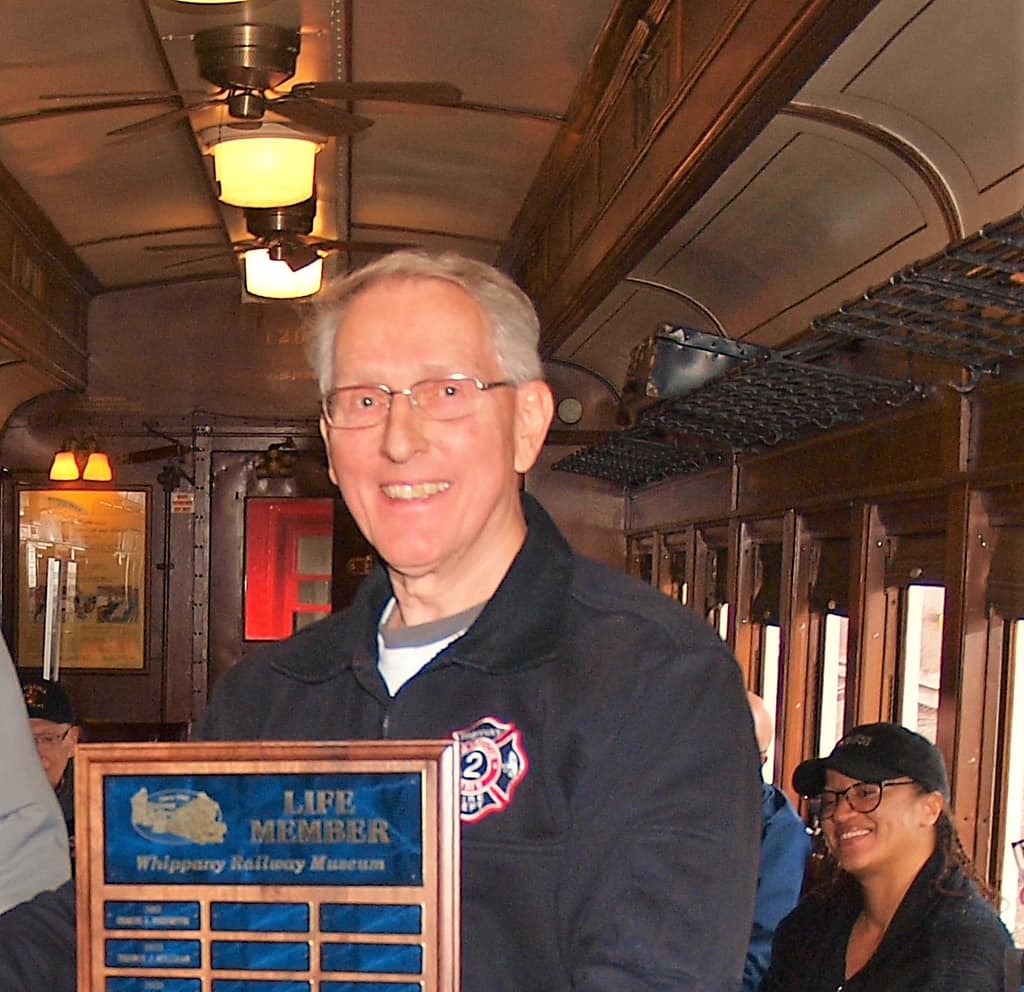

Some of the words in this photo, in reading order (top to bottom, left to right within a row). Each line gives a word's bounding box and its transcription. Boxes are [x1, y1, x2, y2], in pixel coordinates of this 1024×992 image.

[463, 750, 484, 778] 2
[284, 790, 356, 815] LIFE
[250, 819, 392, 845] MEMBER
[136, 855, 226, 875] Whippany
[230, 855, 306, 875] Railway
[310, 855, 385, 872] Museum
